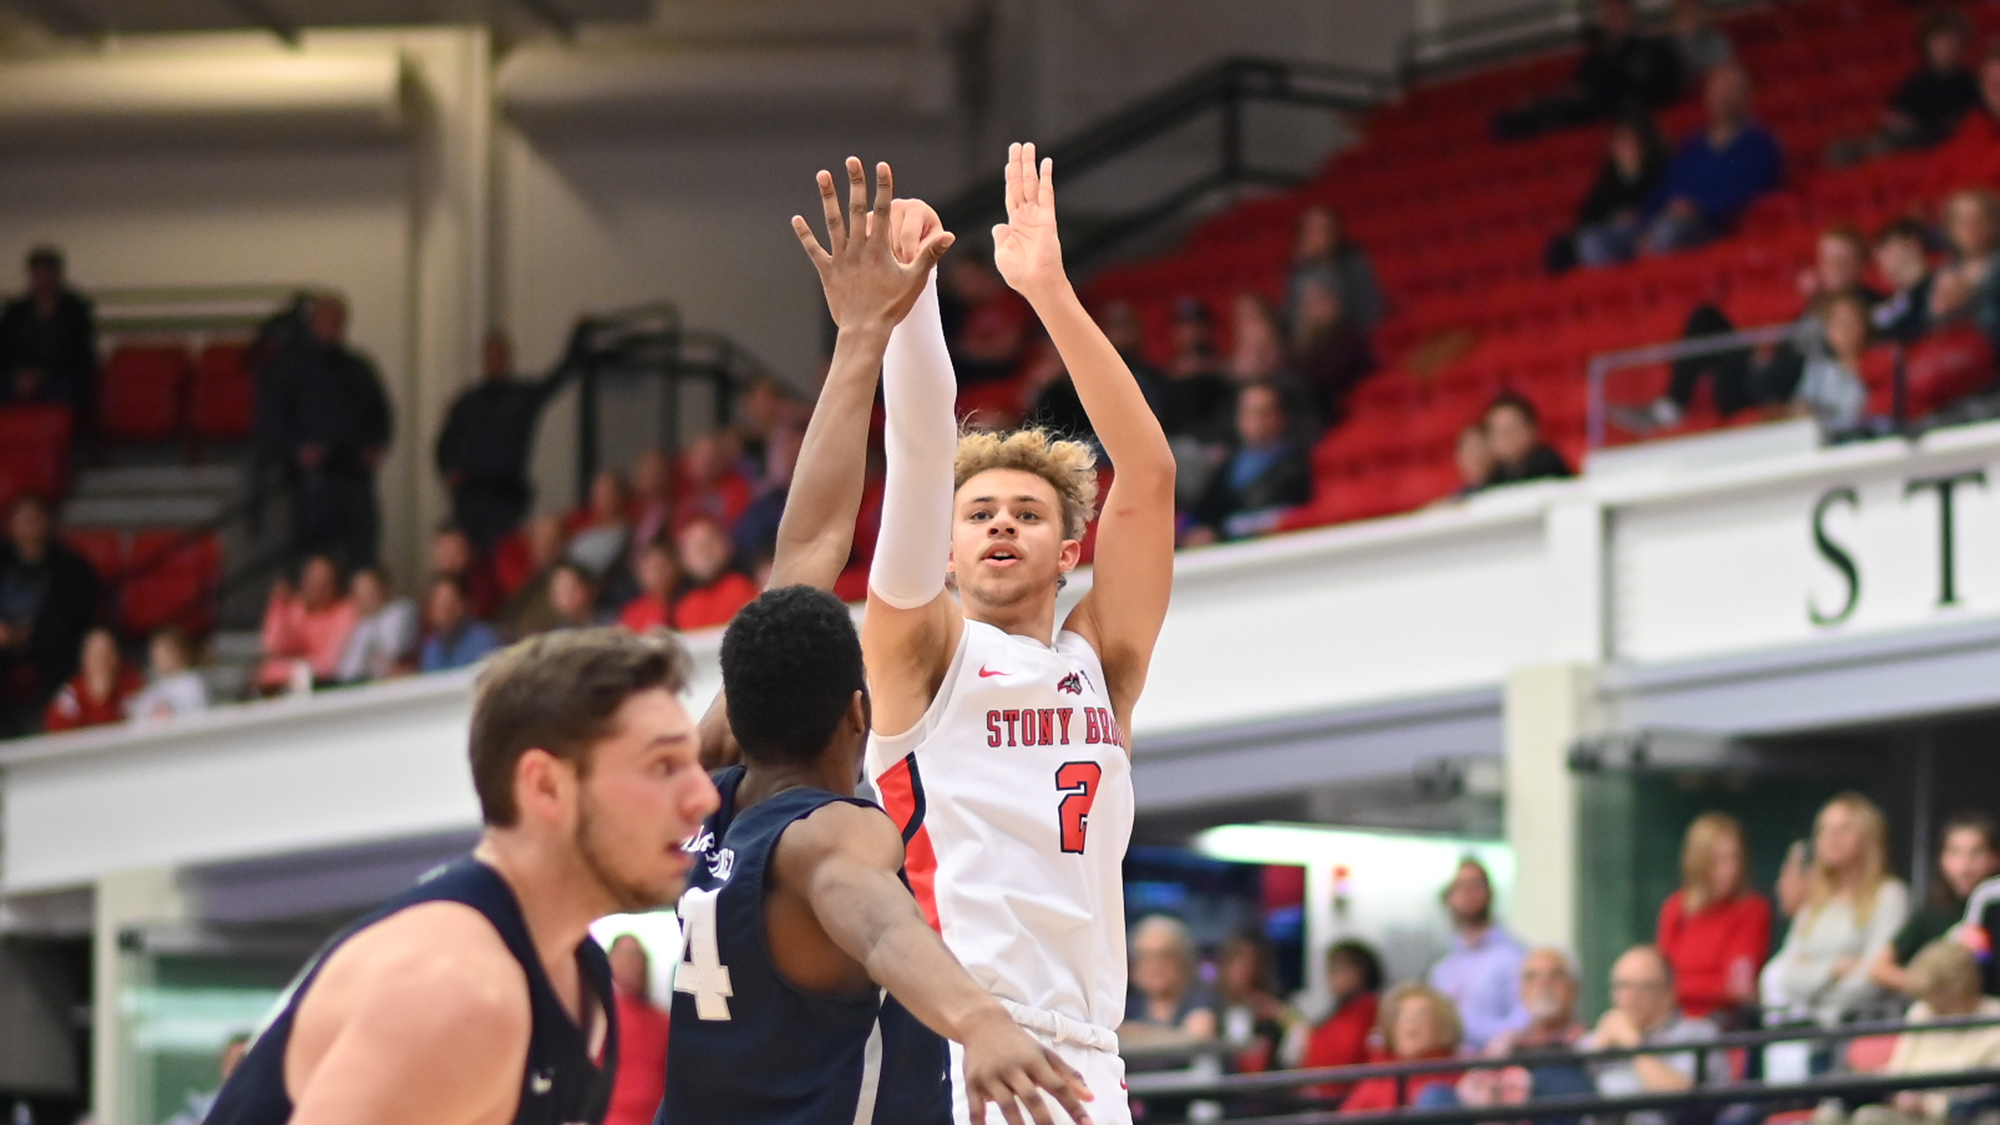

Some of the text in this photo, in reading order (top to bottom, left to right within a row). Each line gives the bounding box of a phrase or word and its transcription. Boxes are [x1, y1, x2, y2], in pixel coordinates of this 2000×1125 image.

[1807, 470, 1986, 627] ST
[987, 708, 1073, 748] STONY
[1055, 761, 1102, 854] 2
